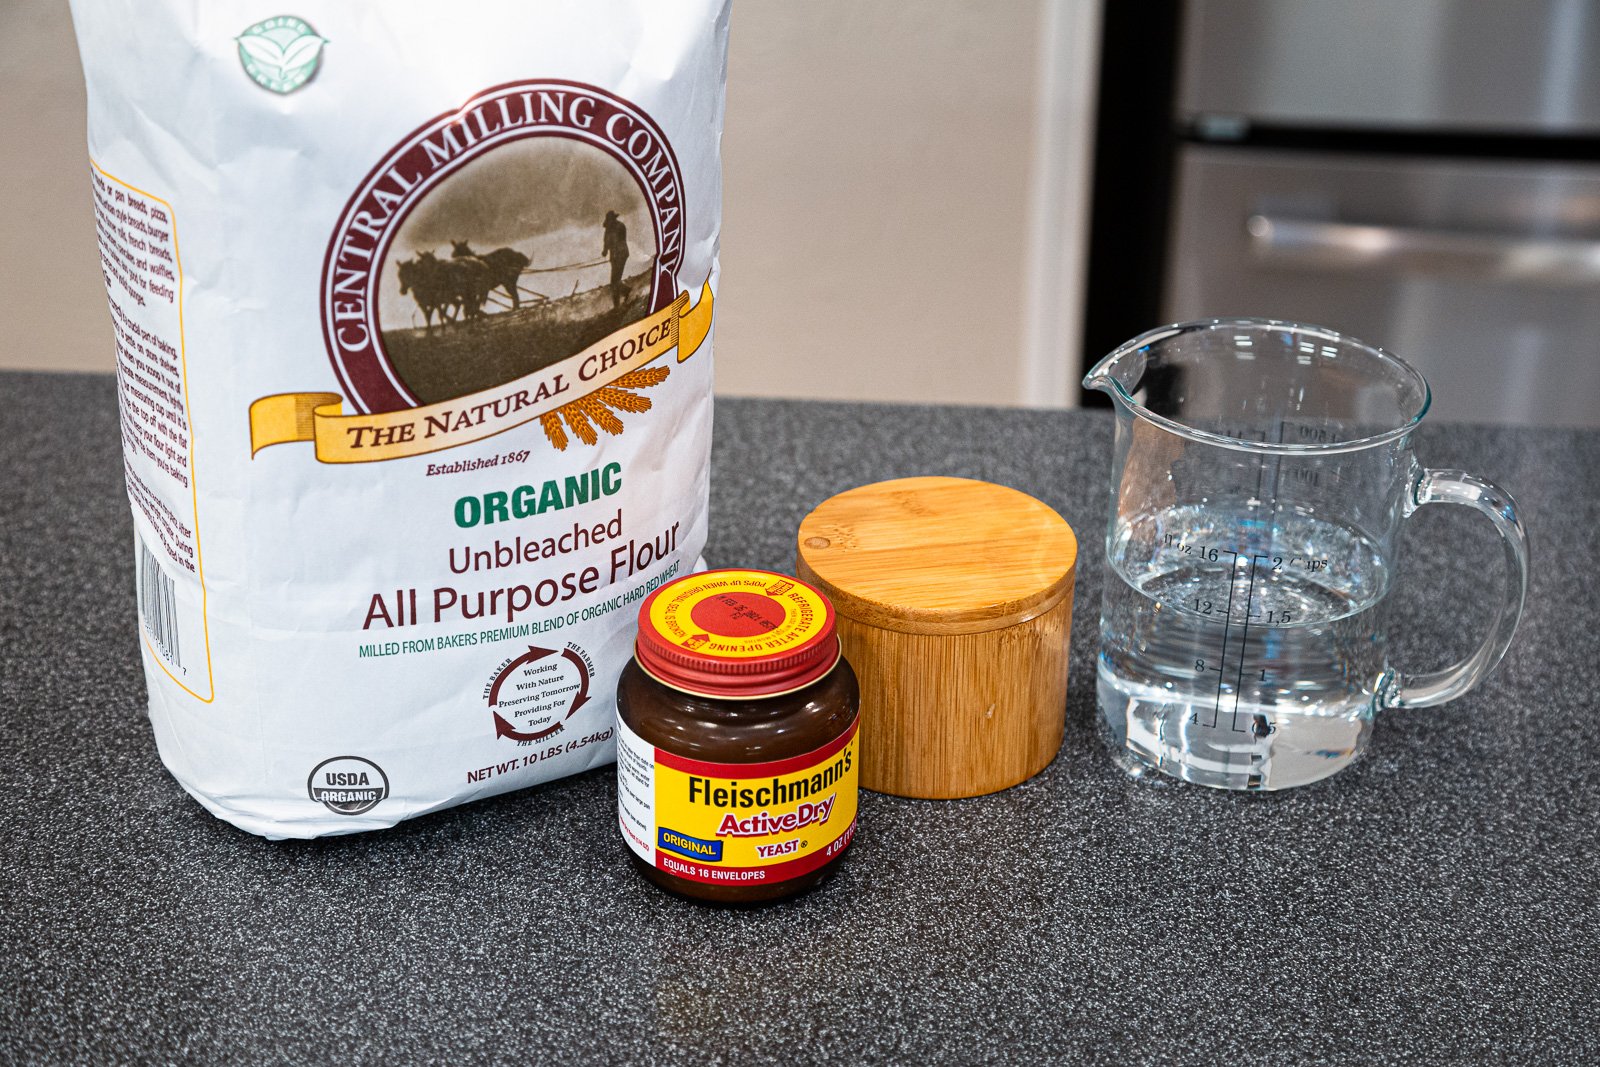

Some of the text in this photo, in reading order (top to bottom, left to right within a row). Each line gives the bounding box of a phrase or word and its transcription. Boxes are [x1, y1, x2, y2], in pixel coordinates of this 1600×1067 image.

[333, 93, 682, 351] CENTRAL MILLING COMPANY
[149, 279, 174, 304] feeding
[347, 317, 672, 449] THE NATURAL CHOICE
[130, 386, 154, 412] measuring
[156, 403, 164, 417] cup
[140, 408, 149, 424] top
[158, 422, 167, 436] with
[169, 428, 177, 443] the
[178, 433, 187, 449] flat
[143, 429, 153, 443] your
[165, 442, 176, 460] light
[177, 454, 187, 468] and
[426, 450, 531, 477] Established 1867
[170, 464, 188, 488] baking
[454, 462, 622, 529] ORGANIC
[179, 522, 191, 538] After
[175, 534, 193, 558] During
[450, 508, 622, 574] Unbleached
[1176, 543, 1192, 555] oz
[1200, 546, 1219, 562] 16
[184, 559, 195, 573] the
[1271, 557, 1283, 570] 2
[362, 521, 679, 630] All Purpose Flour
[705, 581, 729, 589] WHEN
[743, 580, 767, 588] POPS
[359, 560, 680, 658] MILLED FROM BAKERS PREMIUM BLEND OF ORGANIC HARD RED WHEAT
[787, 593, 814, 633] REFRIGERATE
[1194, 598, 1212, 615] 12
[1266, 610, 1291, 626] 1,5
[708, 642, 763, 652] OPENING
[768, 632, 800, 650] AFTER
[523, 663, 558, 677] Working
[567, 642, 595, 678] THE FARMER
[1195, 659, 1205, 672] 8
[490, 658, 513, 684] BAKER
[1259, 669, 1267, 681] 1
[516, 675, 564, 691] With Nature
[499, 683, 581, 708] Preserving Tomorrow
[514, 700, 566, 718] Providing For
[1189, 712, 1199, 726] 4
[528, 715, 552, 727] Today
[535, 725, 565, 744] MILLER
[467, 768, 494, 784] NET
[495, 759, 520, 775] WT.
[523, 754, 538, 767] 10
[540, 745, 563, 761] LBS
[565, 726, 614, 753] (4.54kg)
[326, 772, 370, 786] USDA
[689, 747, 853, 809] Fleischmann's
[321, 791, 377, 802] ORGANIC
[663, 833, 716, 856] ORIGINAL
[757, 840, 799, 858] YEAST
[826, 846, 832, 857] 4
[833, 836, 843, 853] OZ
[663, 858, 766, 881] EQUALS 16 ENVELOPES
